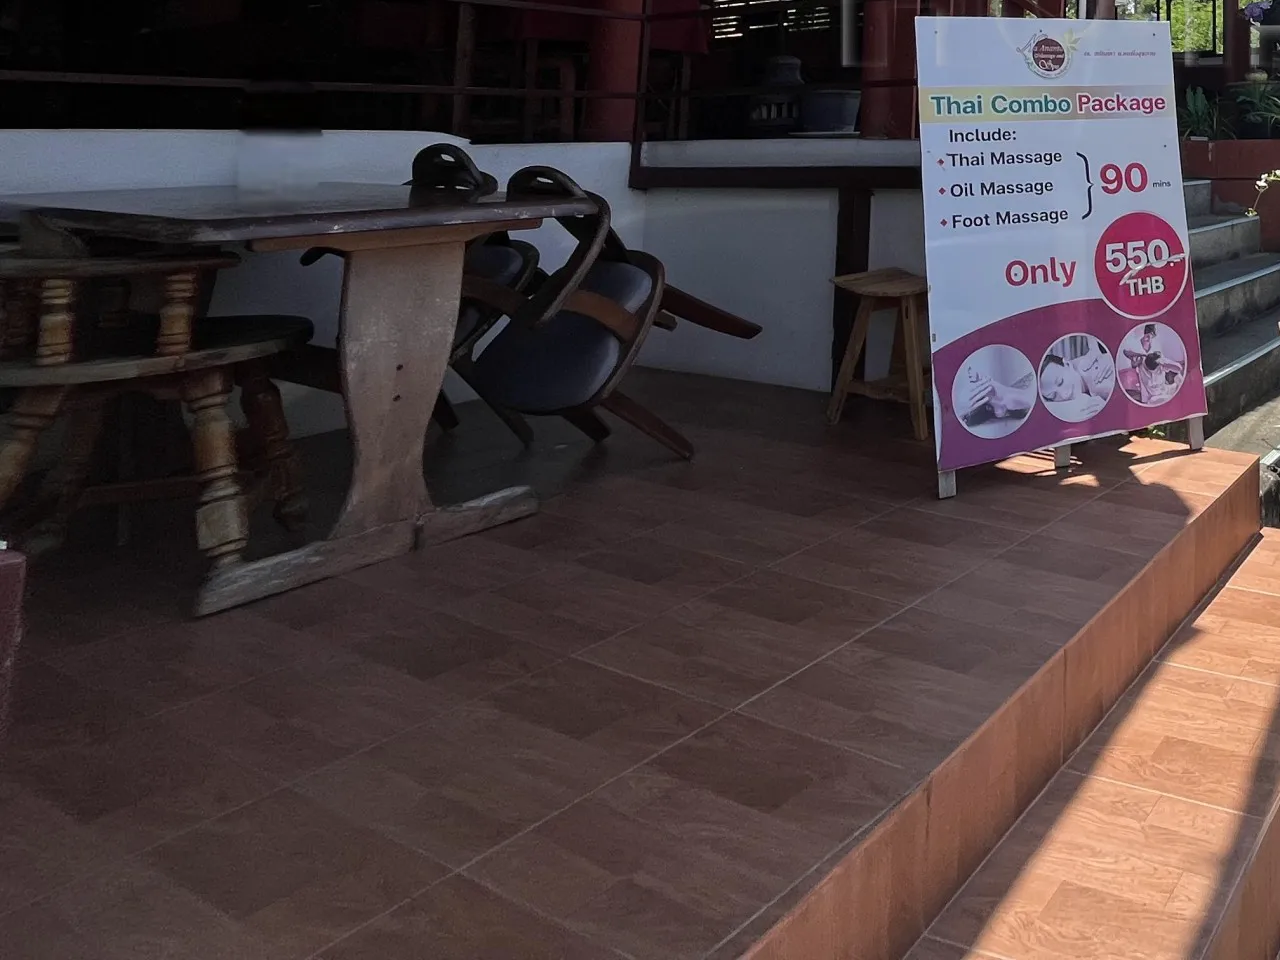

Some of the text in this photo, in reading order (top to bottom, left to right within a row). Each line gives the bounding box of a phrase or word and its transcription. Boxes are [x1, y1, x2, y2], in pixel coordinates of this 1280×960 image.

[930, 93, 1166, 115] Thai Combo Package
[949, 128, 1017, 143] Include:
[947, 150, 1063, 168] Thai Massage
[950, 180, 1054, 198] Oil Massage
[1099, 162, 1171, 195] 90 mins
[952, 210, 1069, 230] Foot Massage
[1004, 256, 1077, 288] Only
[1126, 275, 1165, 297] THB
